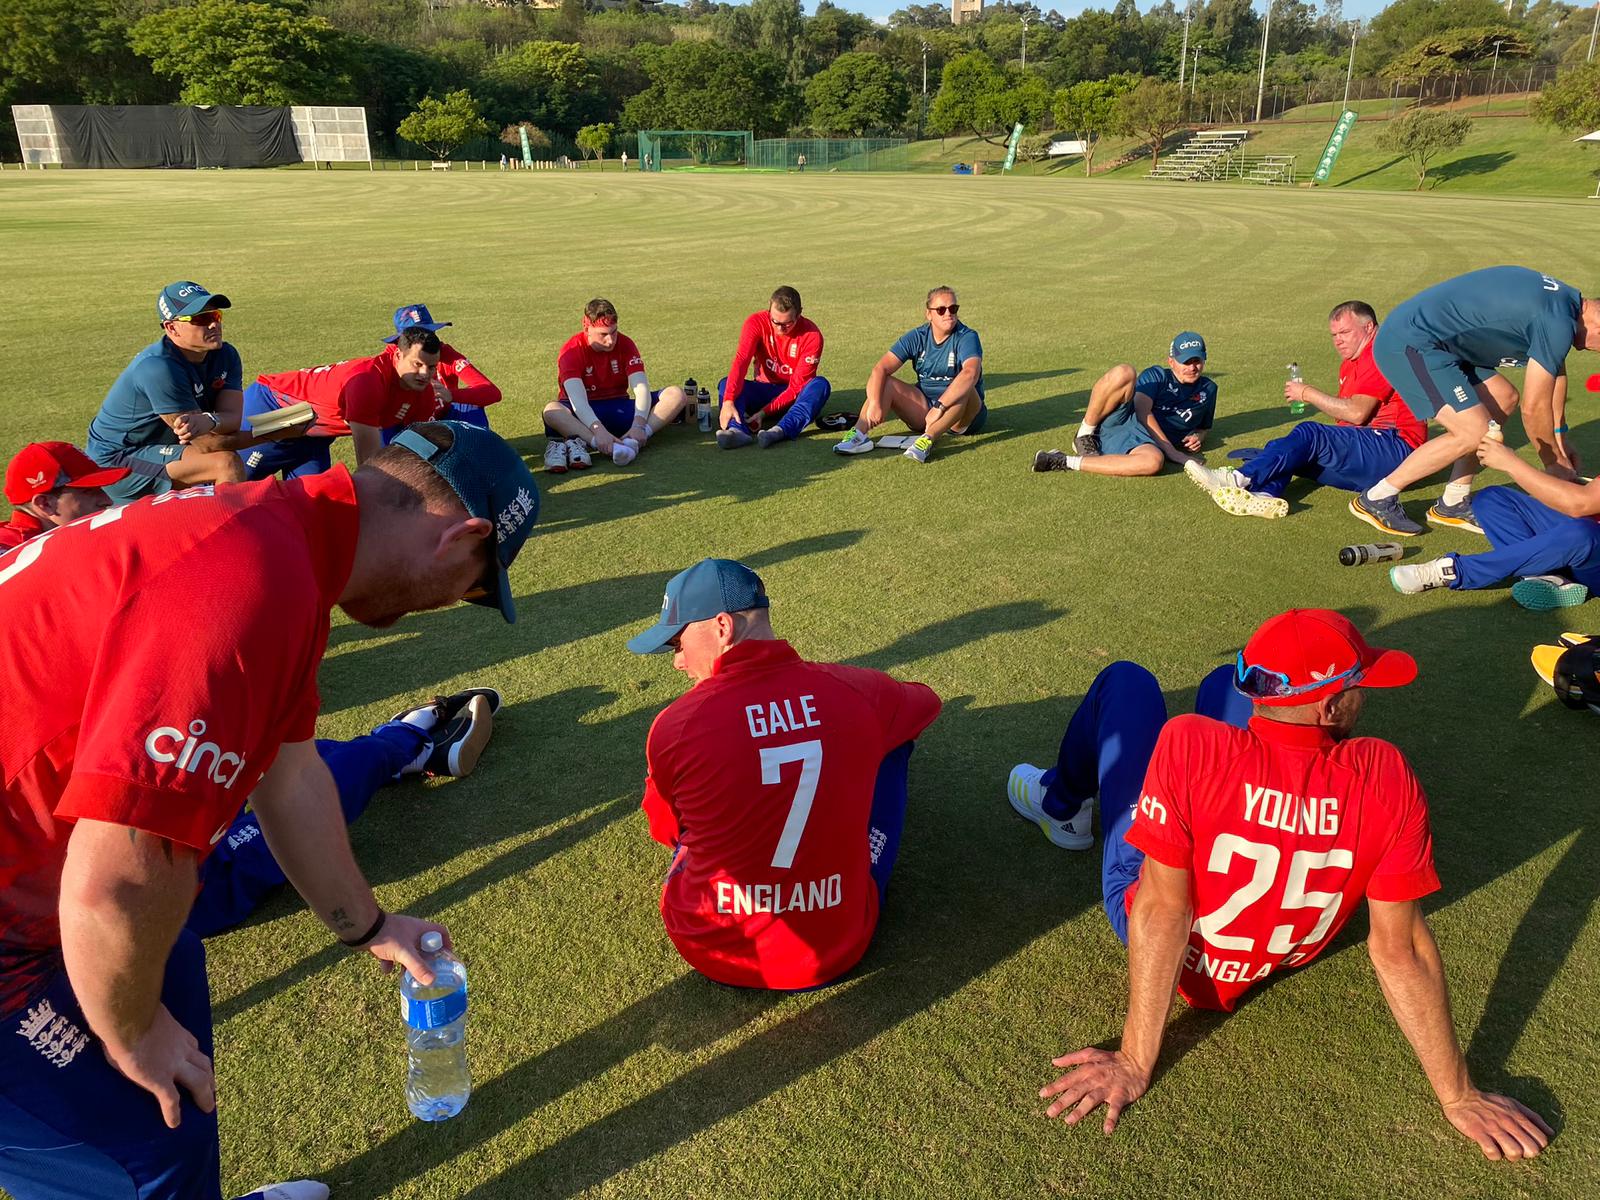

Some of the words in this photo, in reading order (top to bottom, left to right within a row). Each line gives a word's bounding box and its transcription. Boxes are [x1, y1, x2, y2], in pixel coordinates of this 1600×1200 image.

[179, 285, 206, 297] cinc
[1180, 340, 1201, 350] cinch
[745, 694, 821, 738] GALE
[759, 739, 823, 868] 7
[1243, 783, 1338, 835] YOUNG
[717, 873, 842, 915] ENGLAND
[1191, 832, 1353, 954] 25
